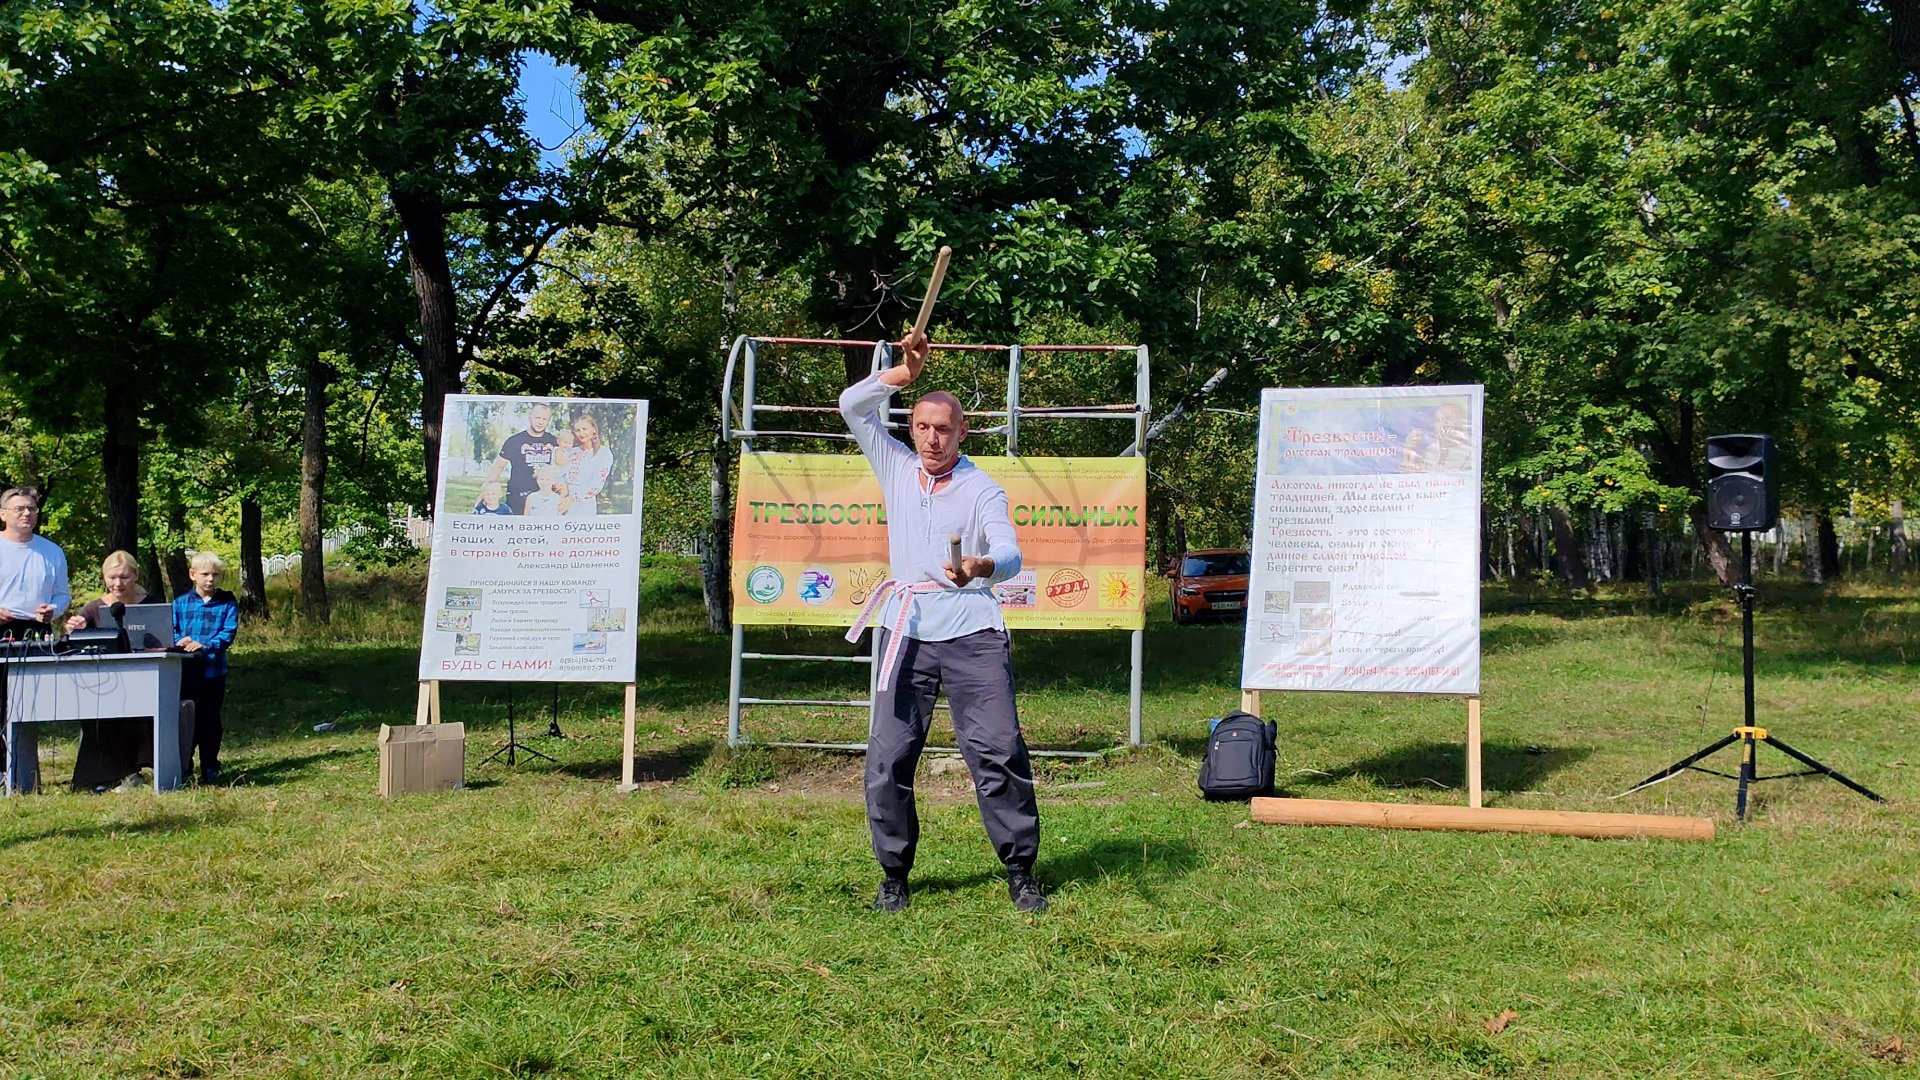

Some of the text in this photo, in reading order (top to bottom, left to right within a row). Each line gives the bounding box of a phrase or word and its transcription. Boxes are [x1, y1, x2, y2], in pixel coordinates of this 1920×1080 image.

[1281, 426, 1384, 446] Трезвость
[1285, 447, 1397, 458] русская традиция
[1271, 480, 1323, 490] Алкоголь
[1328, 480, 1375, 491] никогда
[1380, 480, 1393, 489] не
[1342, 490, 1366, 501] Мы
[1371, 491, 1411, 501] всегда
[1269, 504, 1332, 515] сильными,
[1336, 504, 1402, 515] здоровыми
[1013, 504, 1140, 527] СИЛЬНЫХ
[1269, 515, 1334, 526] трезвыми!
[453, 520, 621, 533] Если нам важно будущее
[1268, 526, 1332, 538] Трезвость
[1347, 528, 1369, 537] это
[451, 535, 620, 546] наших детей, алкоголя
[1267, 539, 1323, 550] человека,
[1328, 540, 1364, 549] семьи
[1369, 540, 1376, 549] и
[450, 548, 620, 560] в стране быть не должно
[1267, 552, 1308, 562] данное
[1312, 551, 1347, 562] самой
[517, 560, 620, 571] Александр Шлеменко
[1267, 562, 1359, 574] Берегите себя!
[561, 579, 597, 587] КОМАНДУ
[442, 660, 553, 672] БУДЬ С НАМИ!
